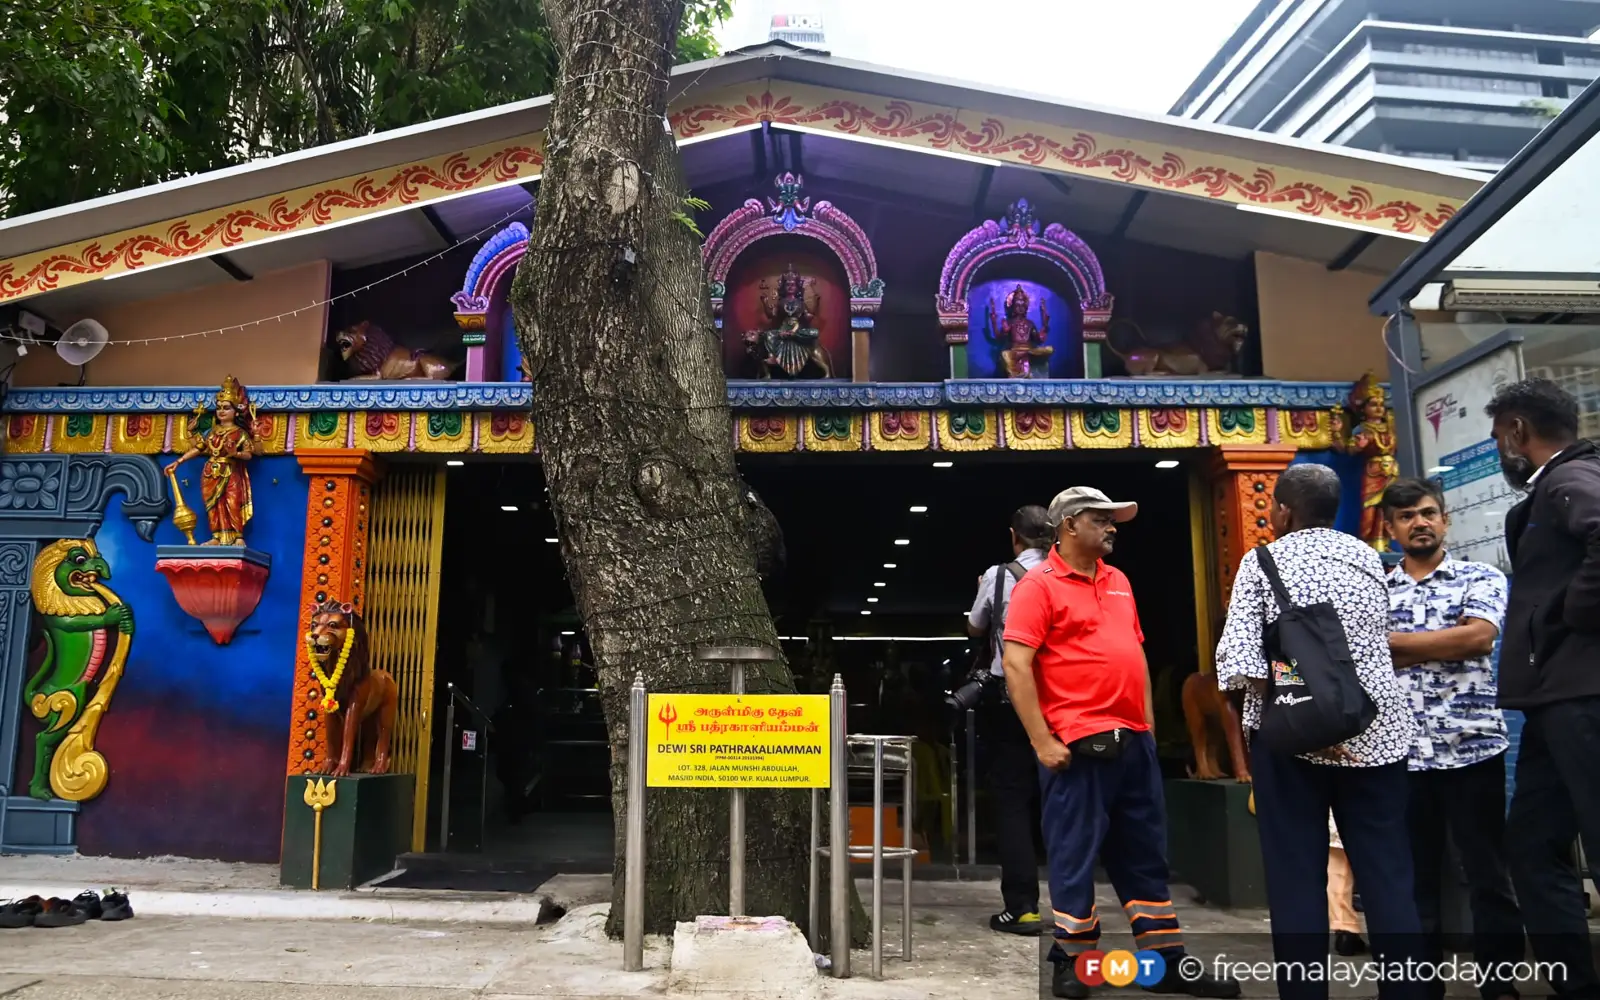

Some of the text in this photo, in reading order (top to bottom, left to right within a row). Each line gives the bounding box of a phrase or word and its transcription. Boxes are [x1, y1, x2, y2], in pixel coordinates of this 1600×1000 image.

[768, 706, 803, 719] தேவி
[657, 744, 822, 755] DEWI SRI PATHRAKALIAMMAN
[693, 765, 707, 773] 328,
[761, 765, 800, 773] ABDULLAH,
[695, 775, 716, 783] INDIA,
[779, 775, 811, 783] LUMPUR.
